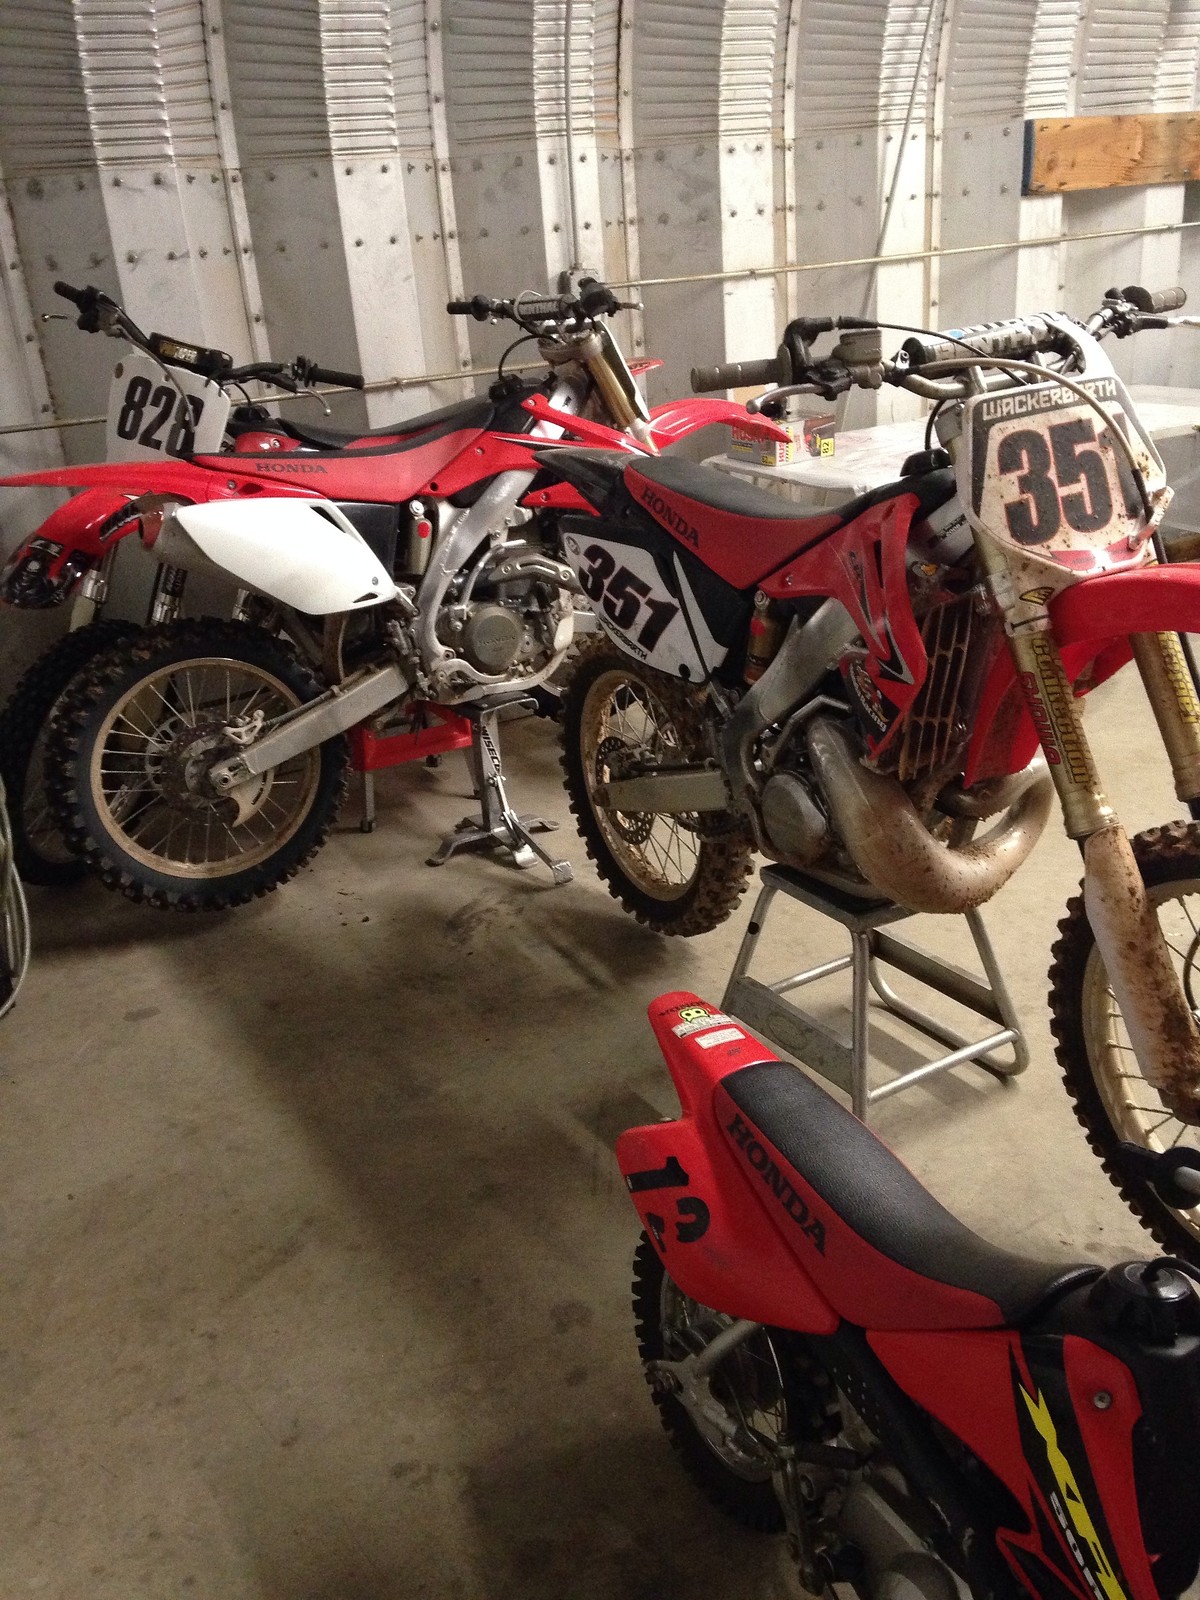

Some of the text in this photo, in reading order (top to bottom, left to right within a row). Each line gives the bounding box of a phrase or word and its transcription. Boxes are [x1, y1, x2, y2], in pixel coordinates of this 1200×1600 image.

[117, 375, 204, 454] 828
[255, 462, 328, 475] HONDA
[997, 412, 1145, 546] 351
[641, 486, 700, 548] HONDA
[578, 543, 680, 654] 351
[1021, 671, 1061, 765] SHOWA
[727, 1113, 826, 1258] HONDA
